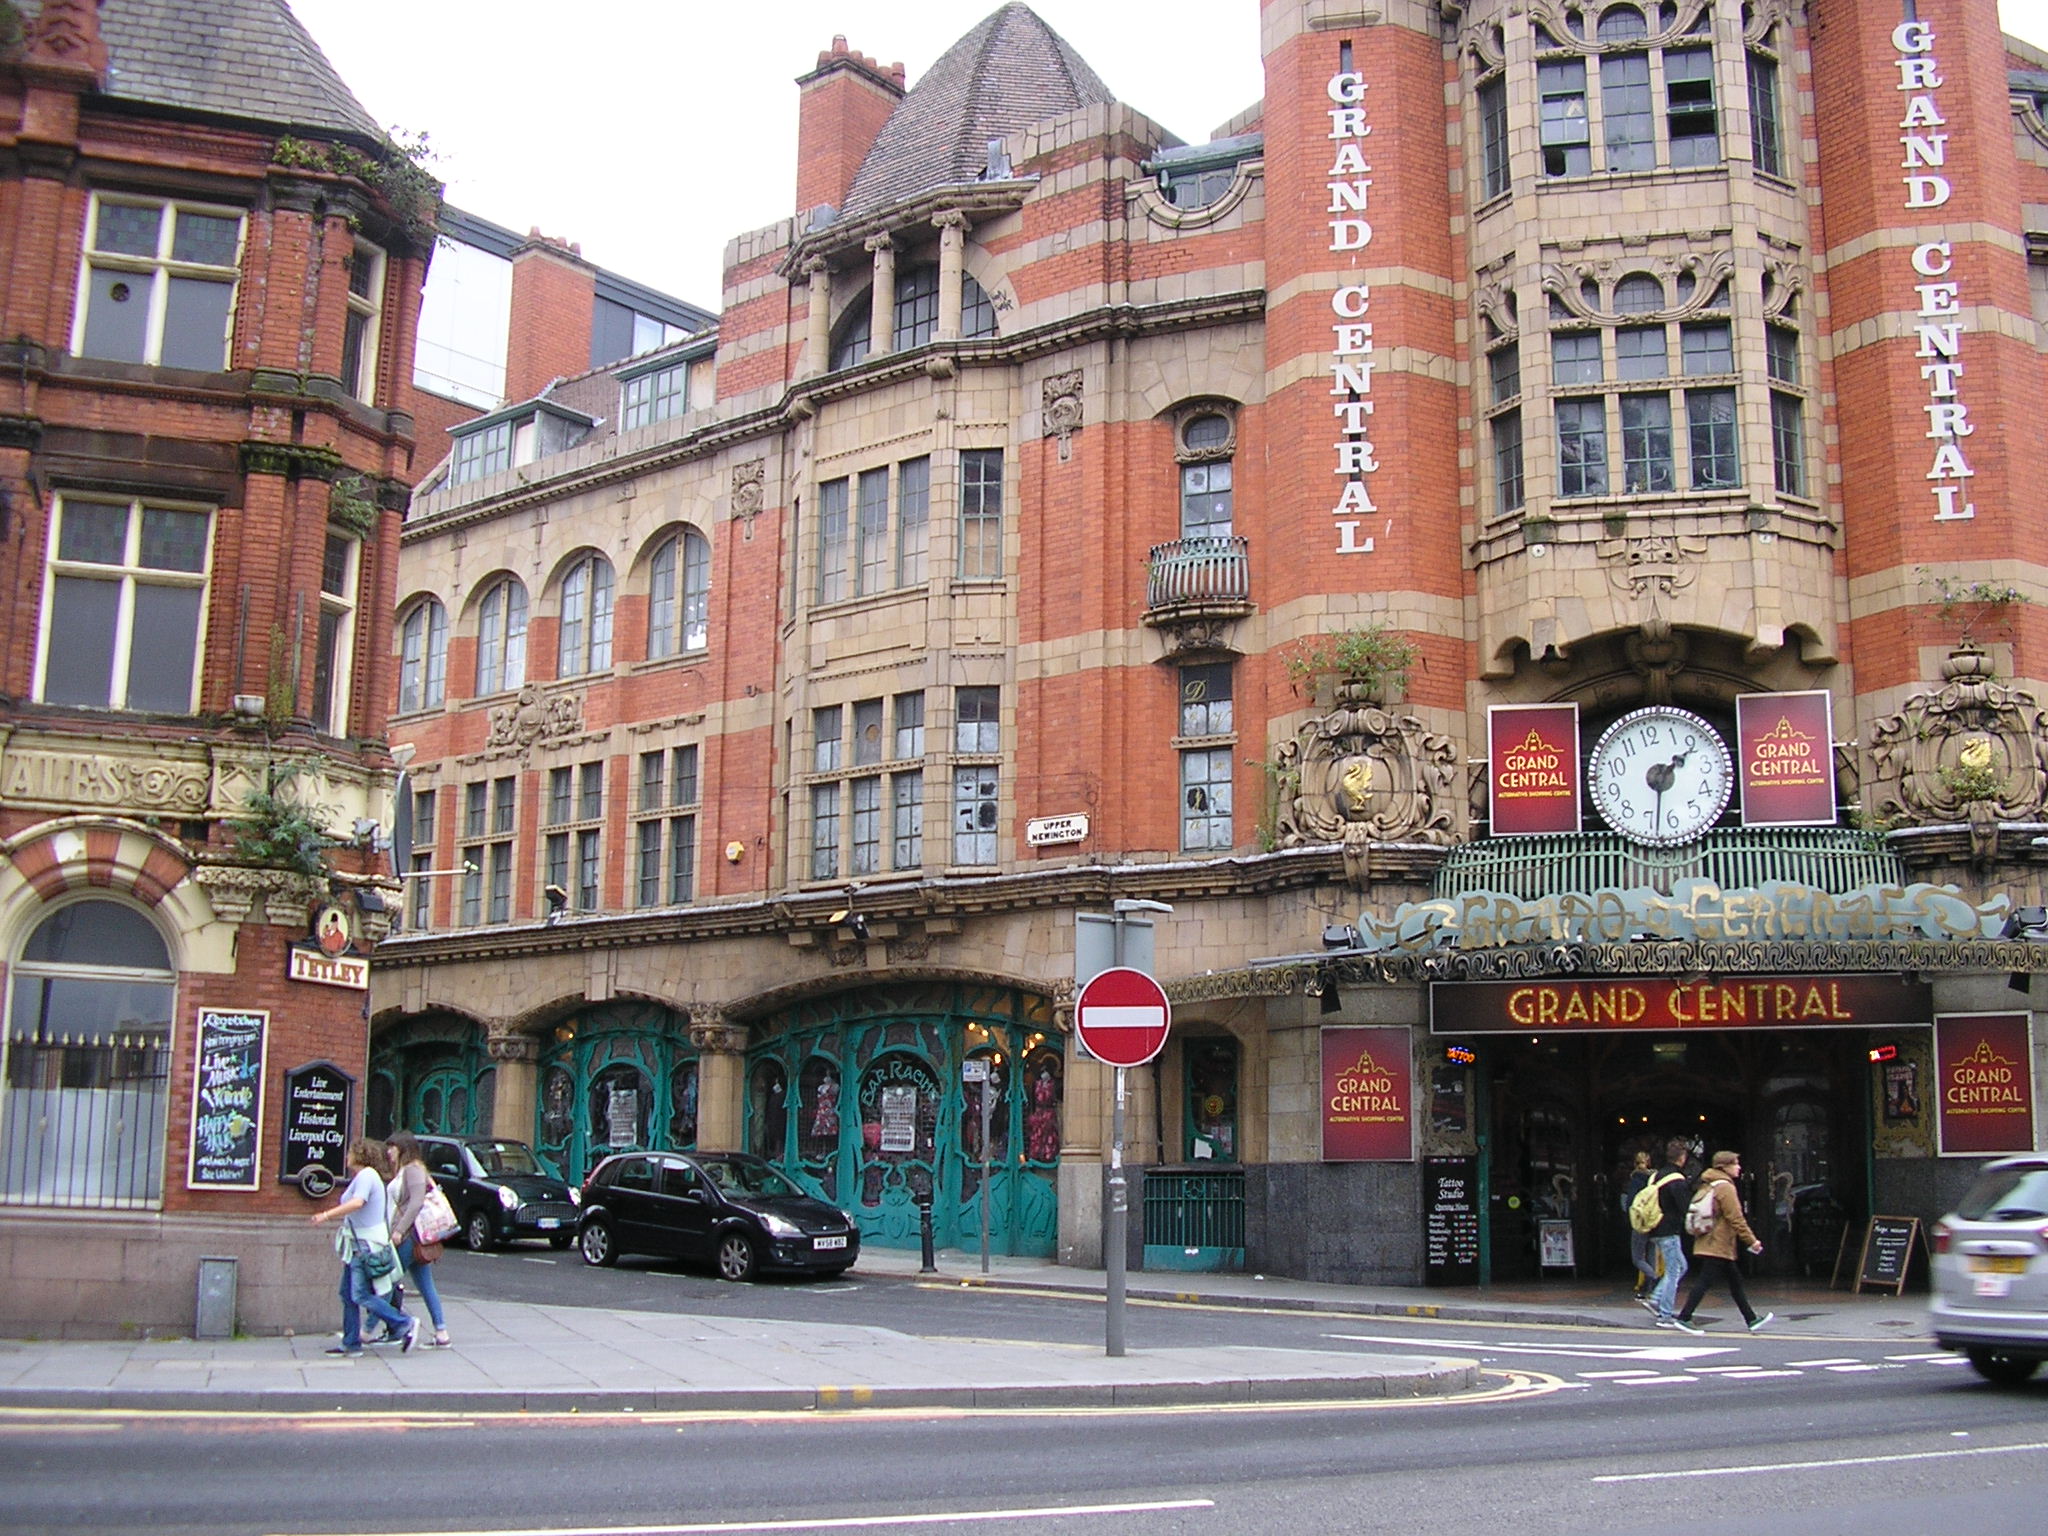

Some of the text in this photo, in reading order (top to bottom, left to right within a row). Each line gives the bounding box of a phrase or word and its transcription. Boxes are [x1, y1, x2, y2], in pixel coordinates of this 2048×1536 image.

[1892, 22, 1974, 522] GRAND CENTRAL
[1327, 72, 1380, 555] GRAND CENTRAL
[1640, 726, 1659, 747] 12
[1669, 728, 1677, 745] 1
[1685, 735, 1698, 753] 2
[1622, 738, 1636, 757] 11
[1756, 742, 1811, 758] GRAND
[1505, 755, 1559, 771] GRAND
[1608, 757, 1626, 778] 10
[1700, 755, 1712, 774] 3
[1750, 759, 1821, 776] CENTRAL
[3, 756, 124, 804] ALES
[1499, 771, 1568, 788] CENTRAL
[1608, 783, 1621, 801] 9
[1698, 780, 1712, 797] 4
[1621, 800, 1635, 819] 8
[1687, 800, 1701, 819] 5
[1043, 820, 1072, 831] UPPER
[1643, 811, 1654, 829] 7
[1666, 809, 1679, 829] 6
[1032, 828, 1083, 841] NEWINGTON
[294, 952, 365, 984] TETLEY
[1508, 983, 1851, 1025] GRAND CENTRAL
[311, 1076, 328, 1088] Live
[1954, 1068, 2012, 1084] GRAND
[293, 1086, 344, 1101] Entertainment
[1337, 1078, 1392, 1094] GRAND
[1947, 1086, 2023, 1103] CENTRAL
[1331, 1096, 1400, 1112] CENTRAL
[298, 1111, 337, 1126] Historical
[289, 1128, 344, 1147] Liverpool City
[307, 1146, 325, 1159] Pub
[1438, 1177, 1464, 1188] Tattoo
[1438, 1188, 1464, 1200] Studio
